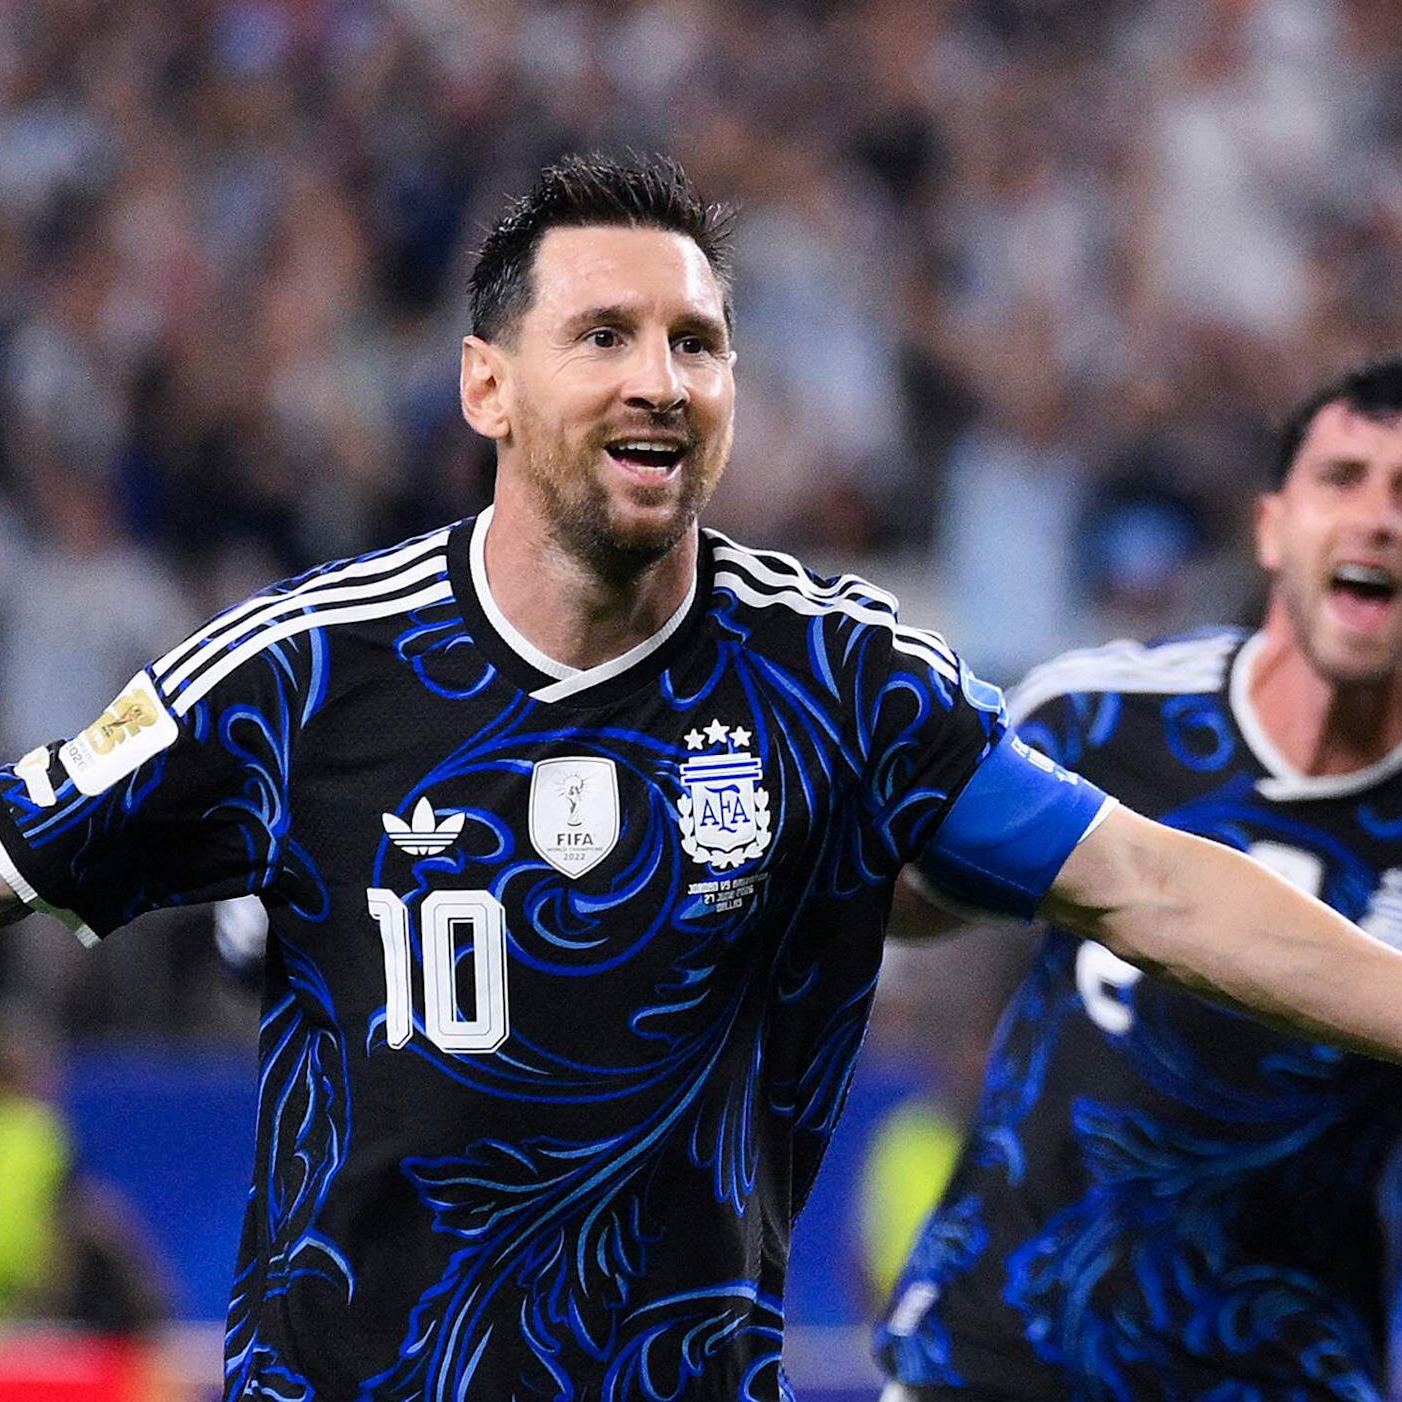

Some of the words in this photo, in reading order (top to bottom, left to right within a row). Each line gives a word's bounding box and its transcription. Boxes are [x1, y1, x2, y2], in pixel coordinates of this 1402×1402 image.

[557, 833, 594, 846] FIFA
[563, 852, 586, 861] 2022
[719, 880, 731, 891] VS
[703, 893, 715, 904] 27
[366, 887, 510, 1054] 10
